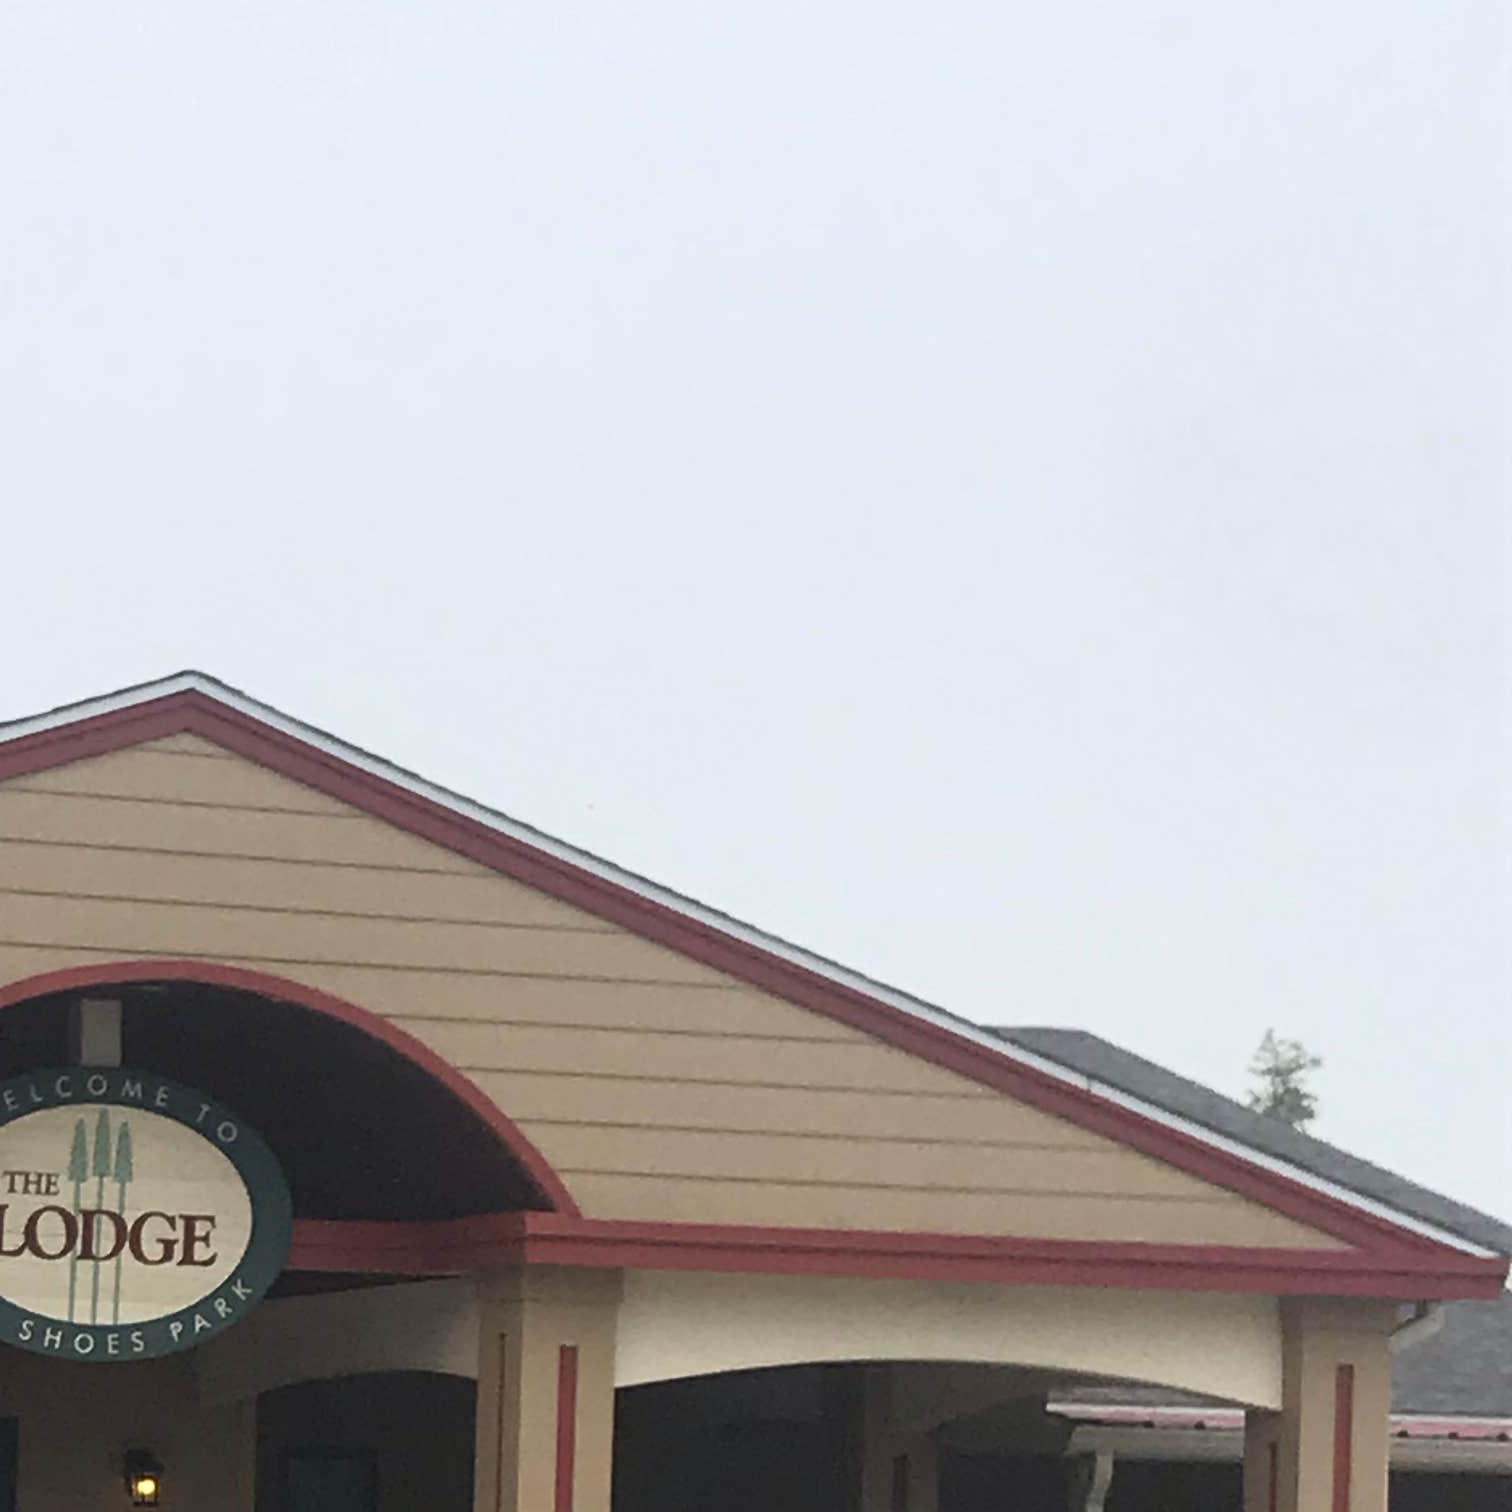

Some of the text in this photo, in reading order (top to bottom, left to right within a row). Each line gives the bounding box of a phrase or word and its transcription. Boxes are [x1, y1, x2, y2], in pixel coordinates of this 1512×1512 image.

[198, 1104, 237, 1142] TO
[3, 1170, 60, 1196] THE
[19, 1320, 144, 1354] SHOES
[169, 1279, 253, 1342] PARK
